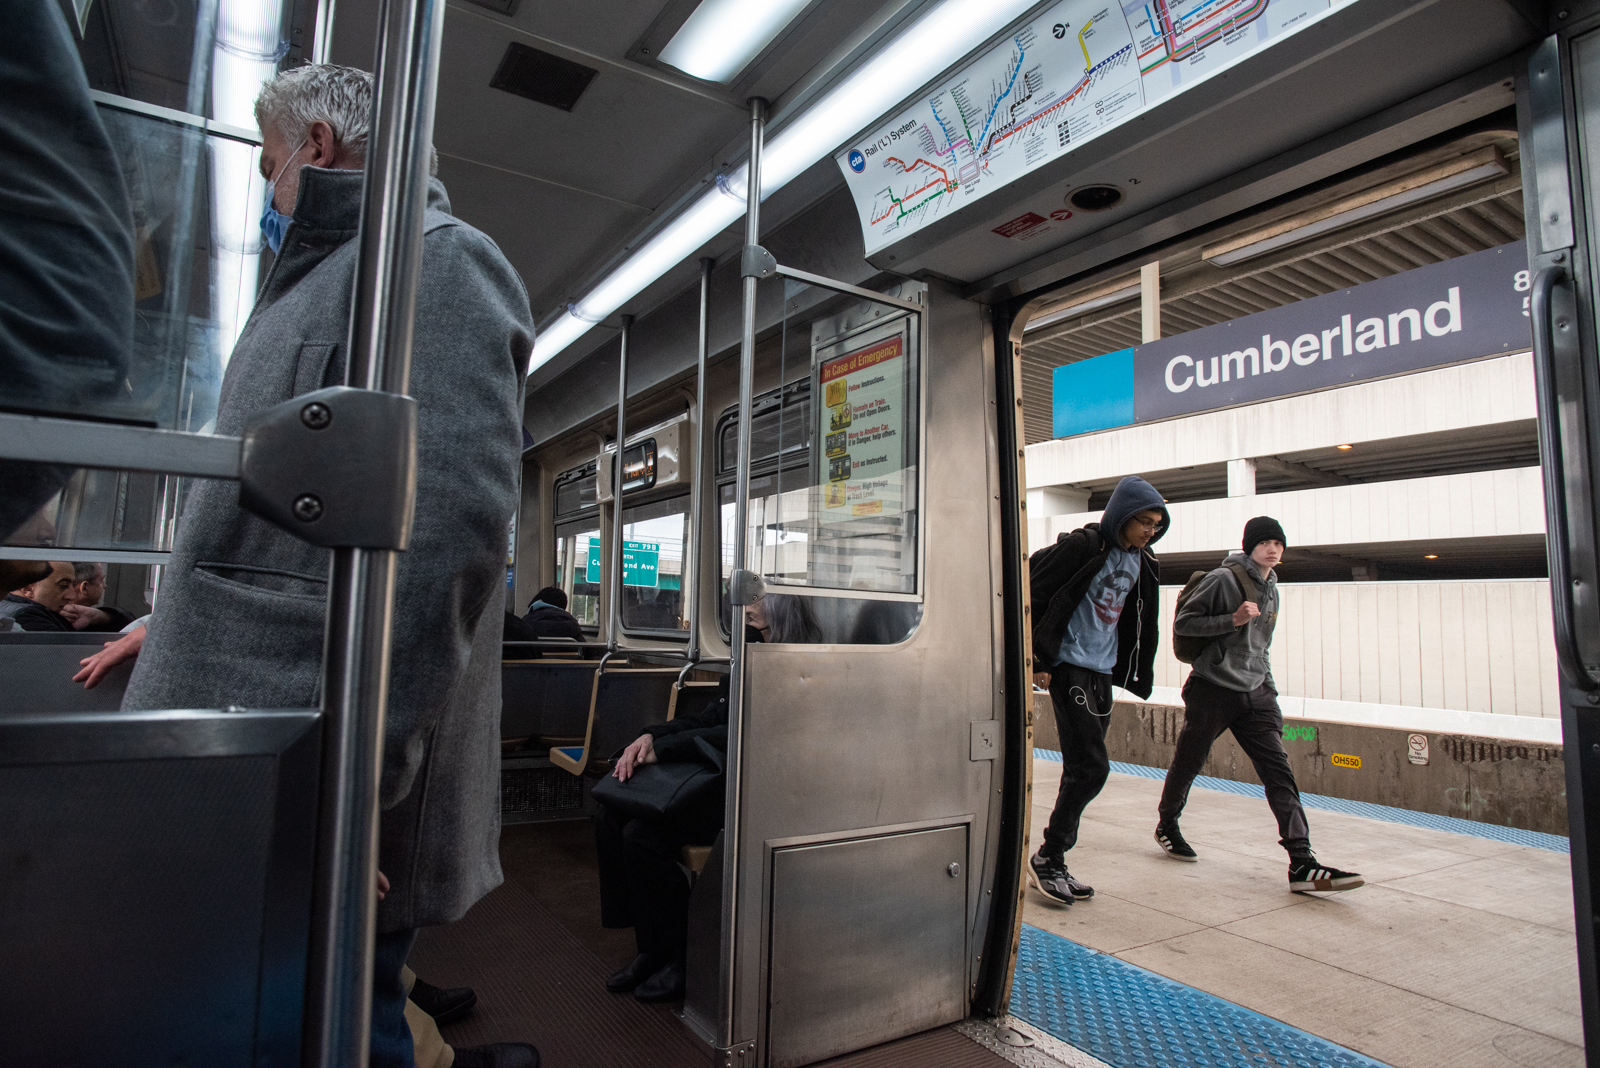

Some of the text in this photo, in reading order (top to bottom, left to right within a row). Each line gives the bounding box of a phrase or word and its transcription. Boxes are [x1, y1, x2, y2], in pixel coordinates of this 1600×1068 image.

[864, 143, 879, 158] Rail
[890, 119, 918, 141] System
[851, 155, 863, 167] cta
[1165, 286, 1463, 394] Cumberland
[824, 343, 898, 379] In Case of Emergency
[642, 543, 657, 551] 79B
[1333, 755, 1360, 767] OH550
